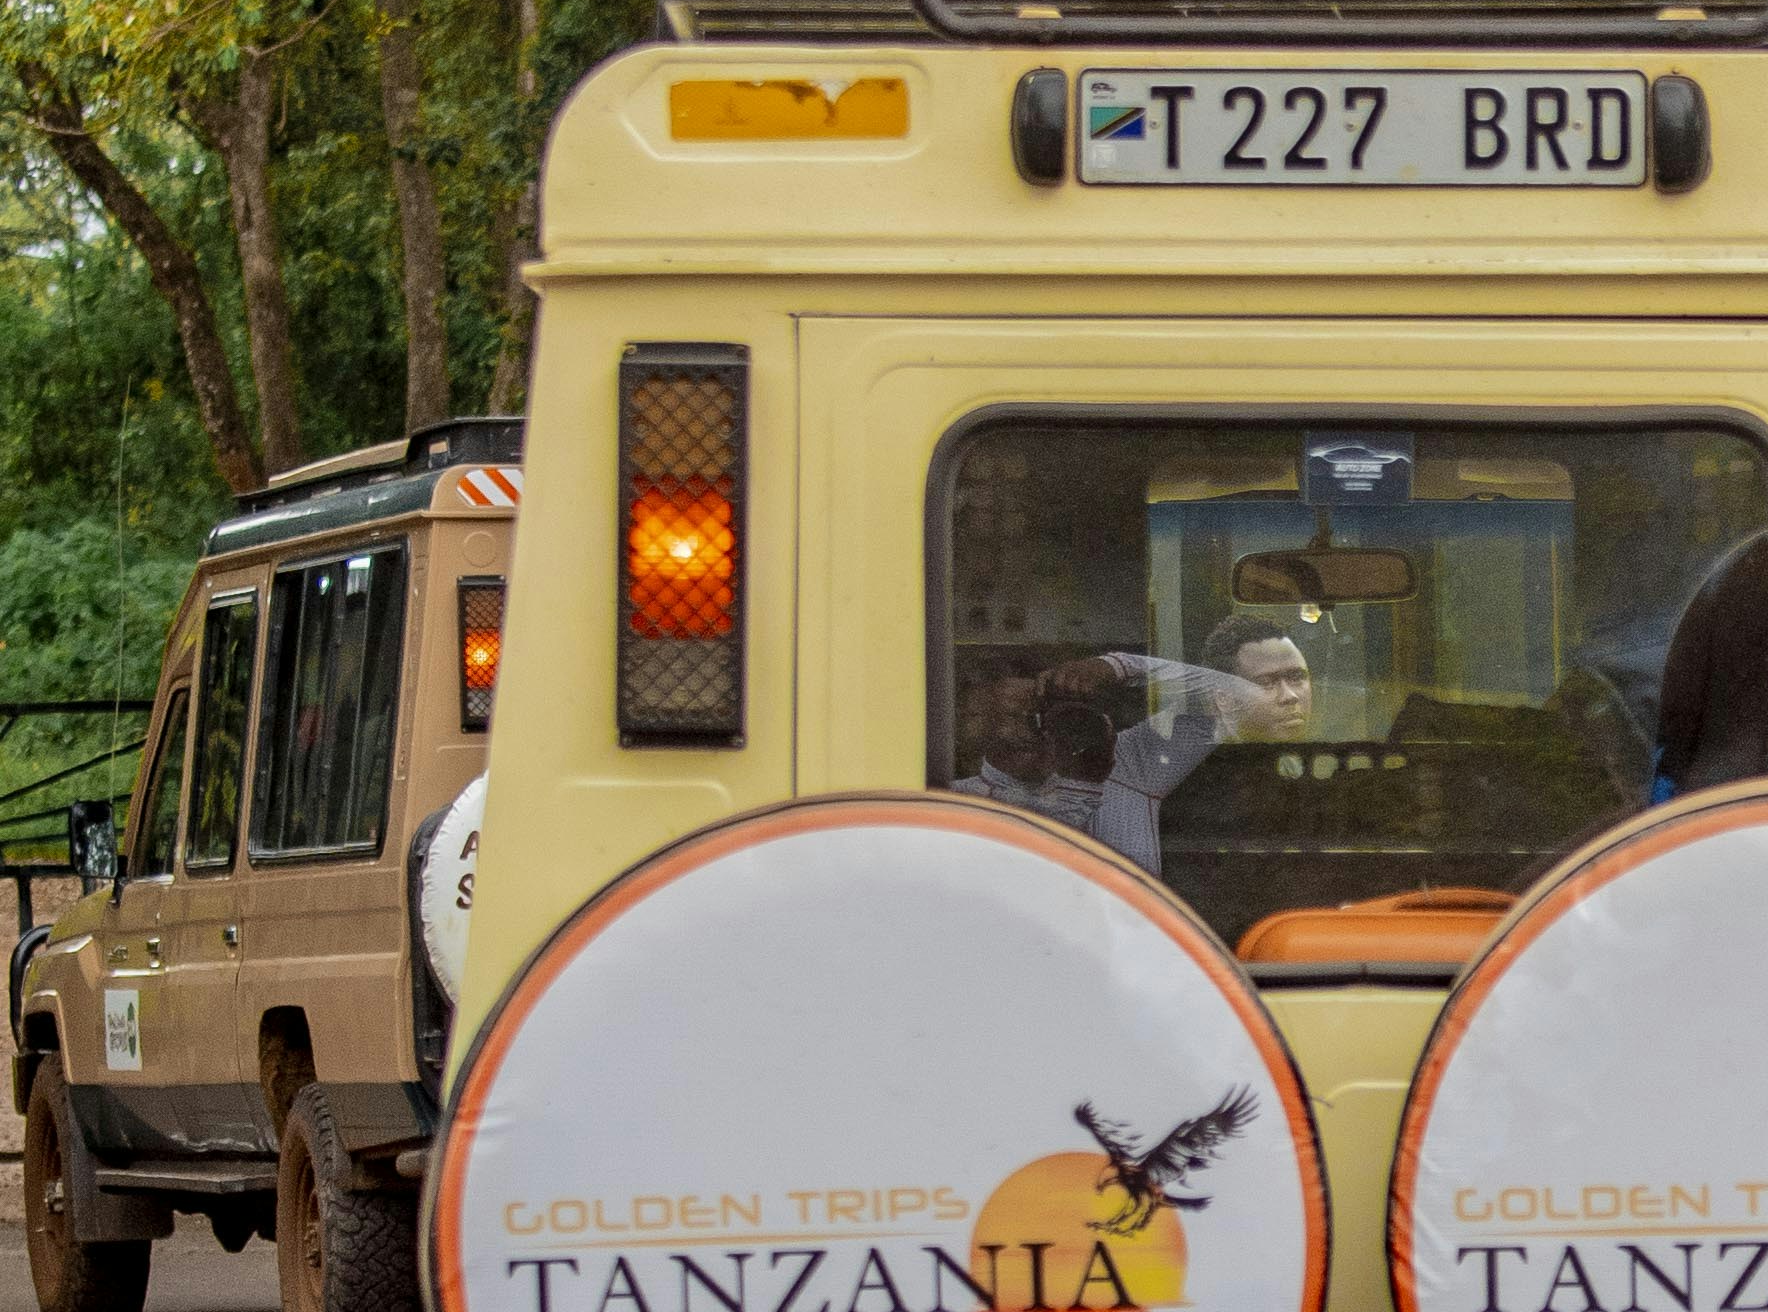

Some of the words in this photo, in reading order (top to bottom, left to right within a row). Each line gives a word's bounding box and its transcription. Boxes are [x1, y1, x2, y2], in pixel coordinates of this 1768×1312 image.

[1151, 85, 1194, 170] T
[1222, 86, 1388, 170] 227
[1464, 86, 1632, 172] BRD
[504, 1193, 762, 1236] GOLDEN
[786, 1186, 971, 1225] TRIPS
[1452, 1183, 1711, 1223] GOLDEN
